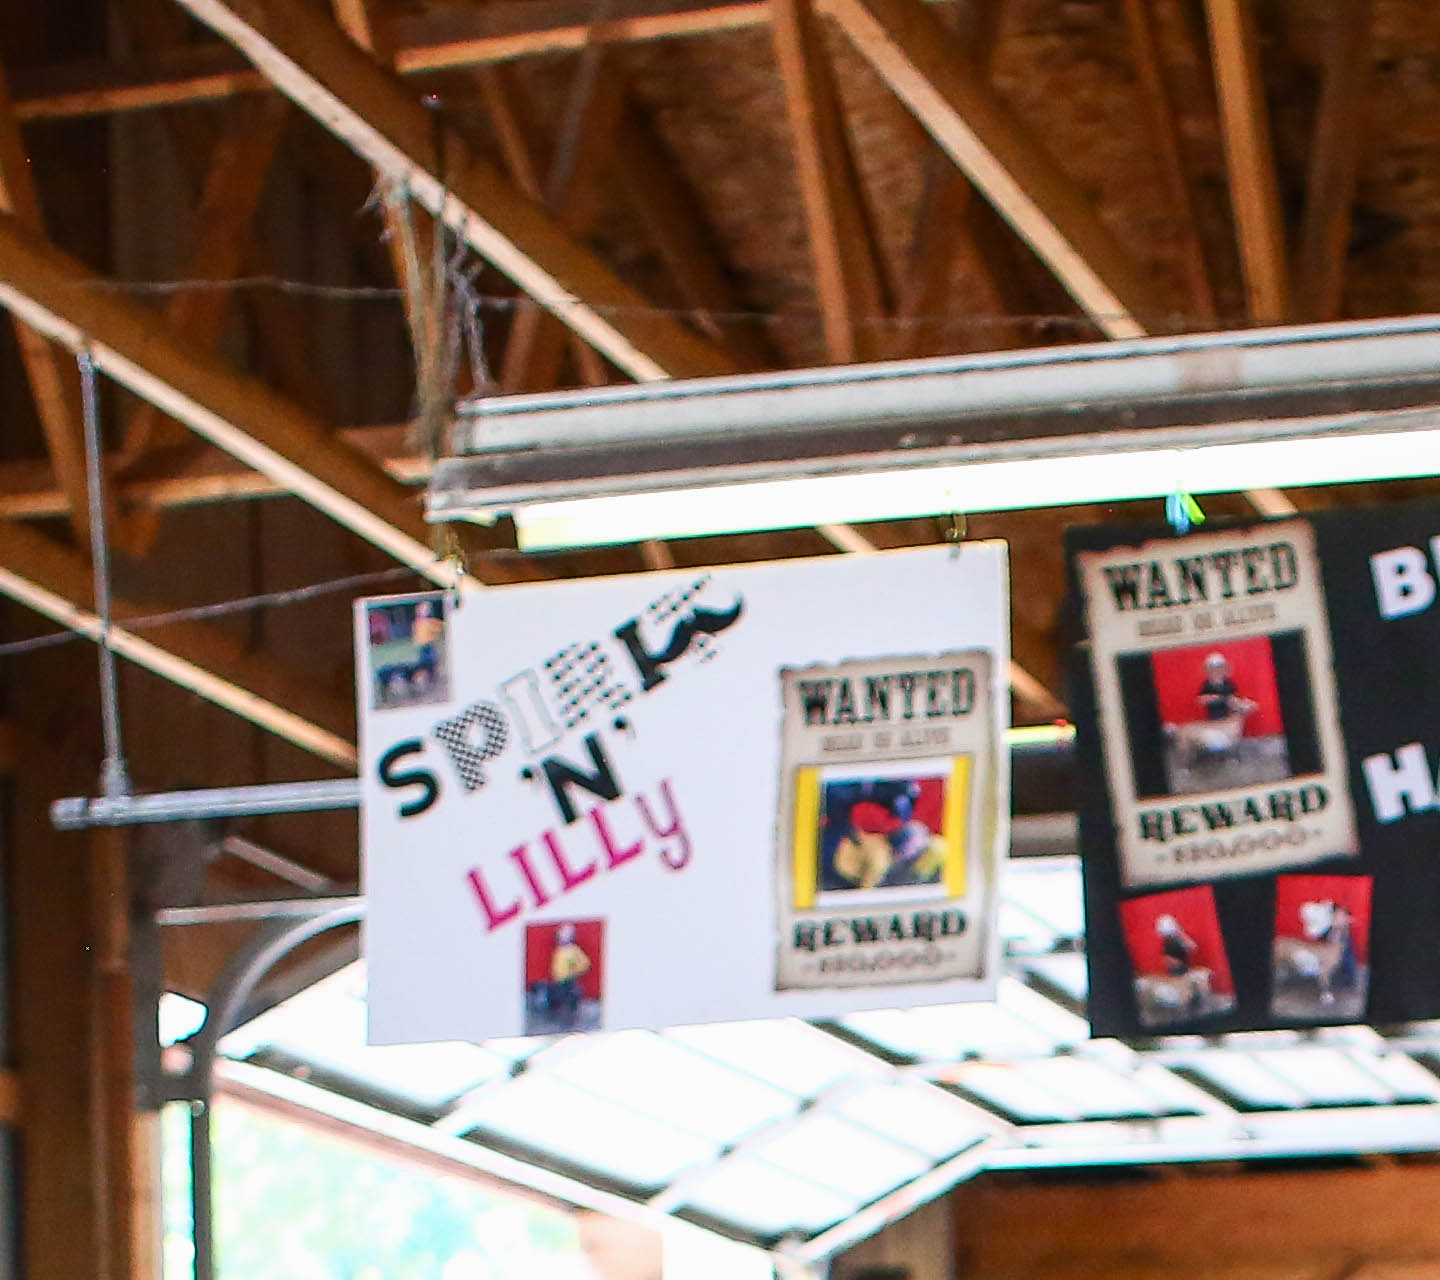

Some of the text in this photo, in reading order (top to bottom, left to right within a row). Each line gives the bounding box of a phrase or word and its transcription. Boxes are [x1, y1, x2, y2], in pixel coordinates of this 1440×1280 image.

[1102, 541, 1298, 610] WANTED
[799, 668, 976, 727] WANTED
[1139, 784, 1329, 842] REWARD
[793, 909, 968, 951] REWARD
